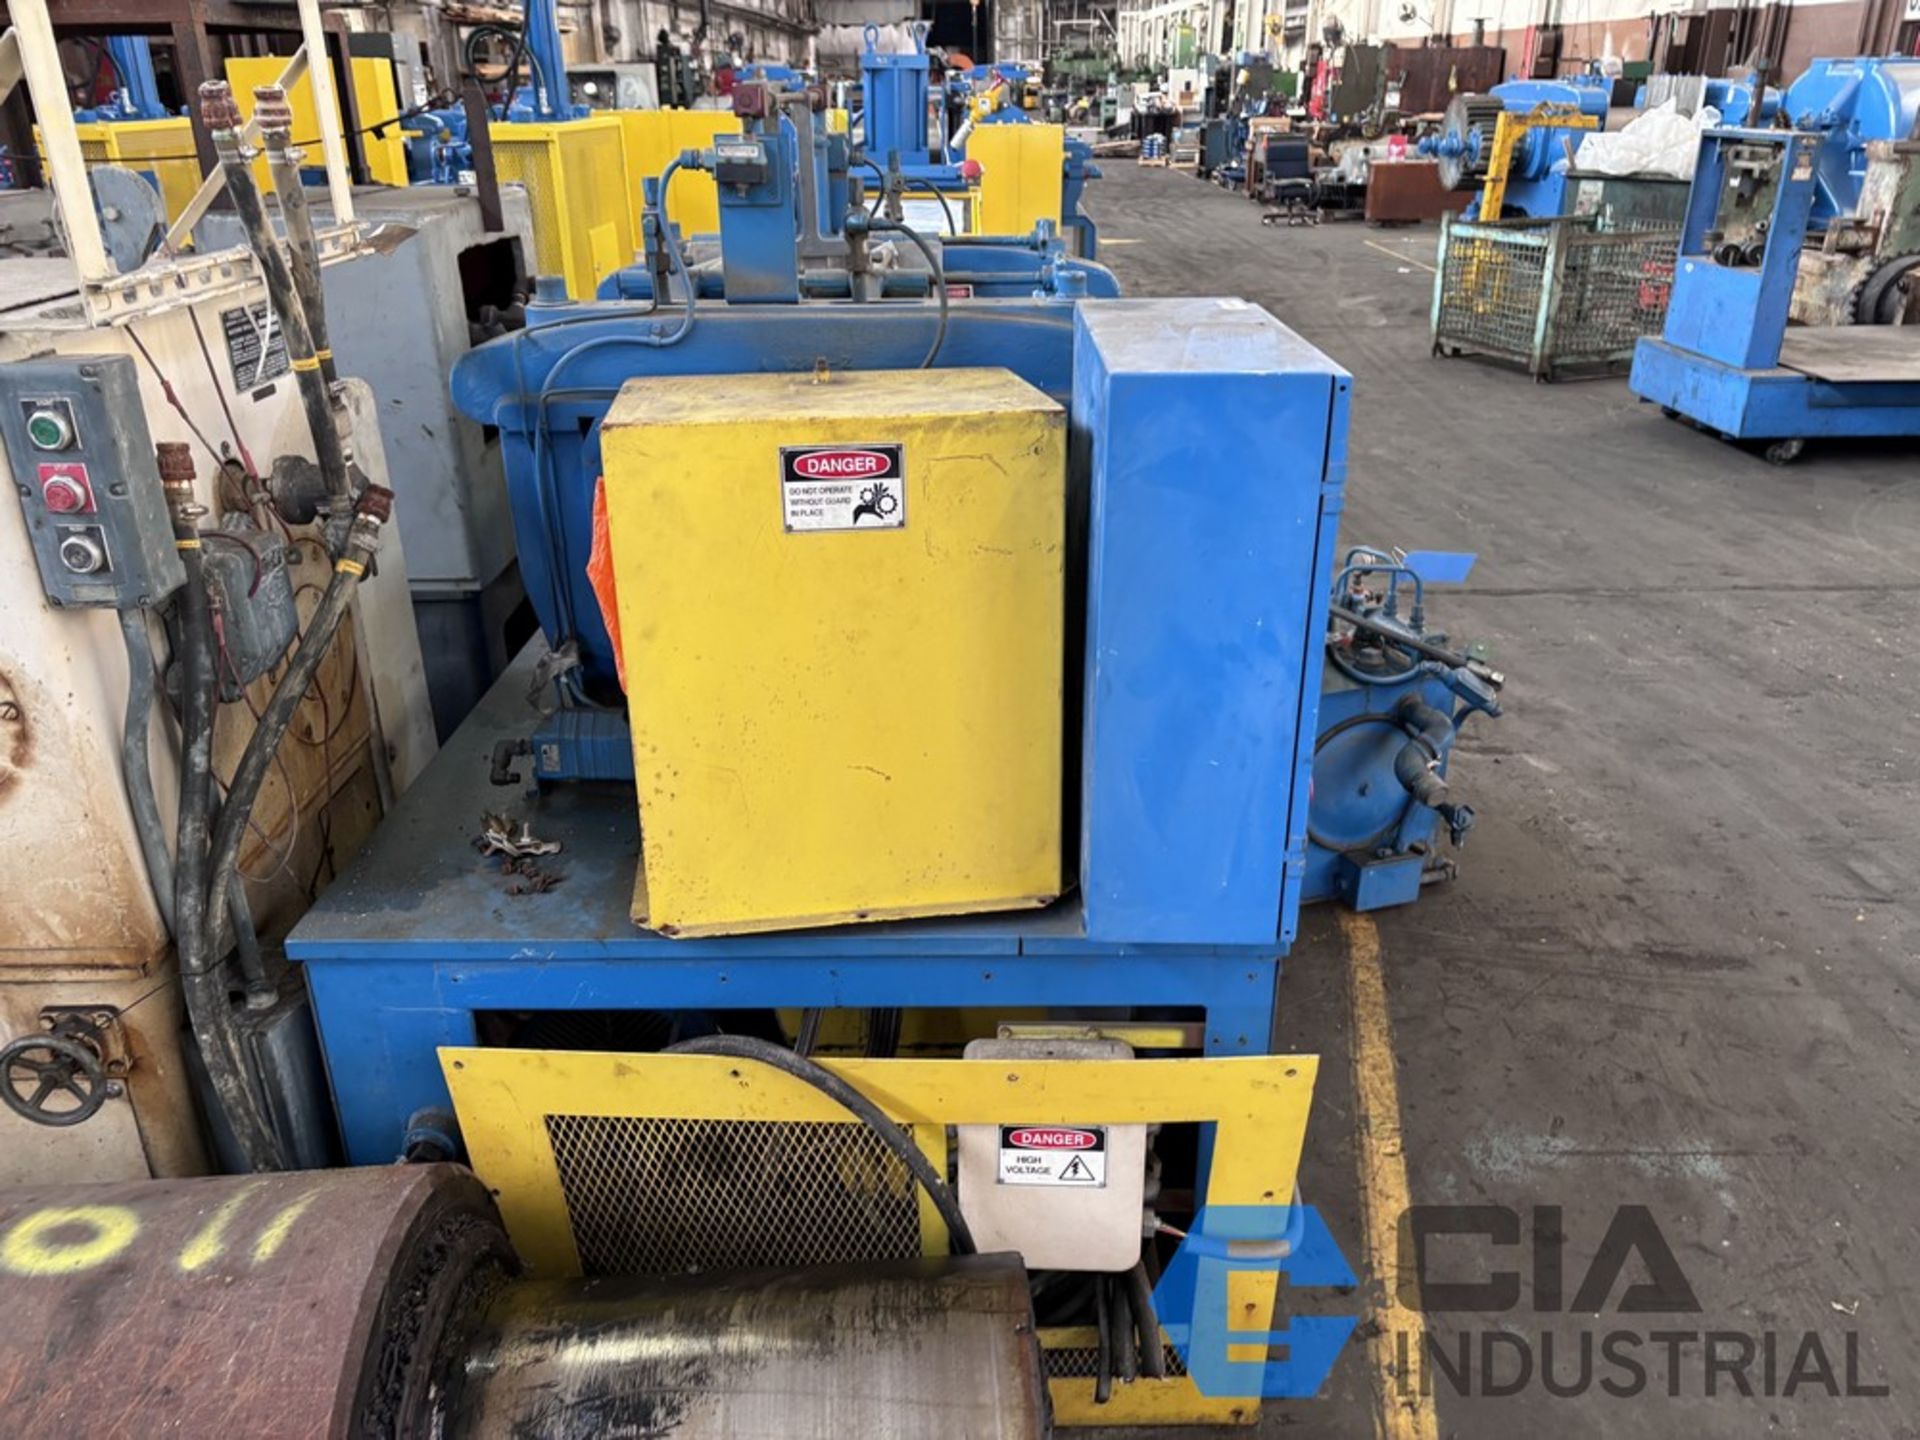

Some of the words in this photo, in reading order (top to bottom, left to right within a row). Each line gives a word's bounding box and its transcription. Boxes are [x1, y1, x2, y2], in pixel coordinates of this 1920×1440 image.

[807, 456, 877, 473] DANGER
[789, 487, 801, 496] DO
[802, 487, 817, 495] NOT
[818, 485, 853, 494] OPERATE
[790, 497, 824, 506] WITHOUT
[825, 496, 851, 505] GUARD
[791, 509, 799, 517] IN
[800, 508, 823, 517] PLACE
[1021, 1132, 1085, 1145] DANGER
[1016, 1155, 1042, 1164] HIGH
[1005, 1165, 1052, 1175] VOLTAGE
